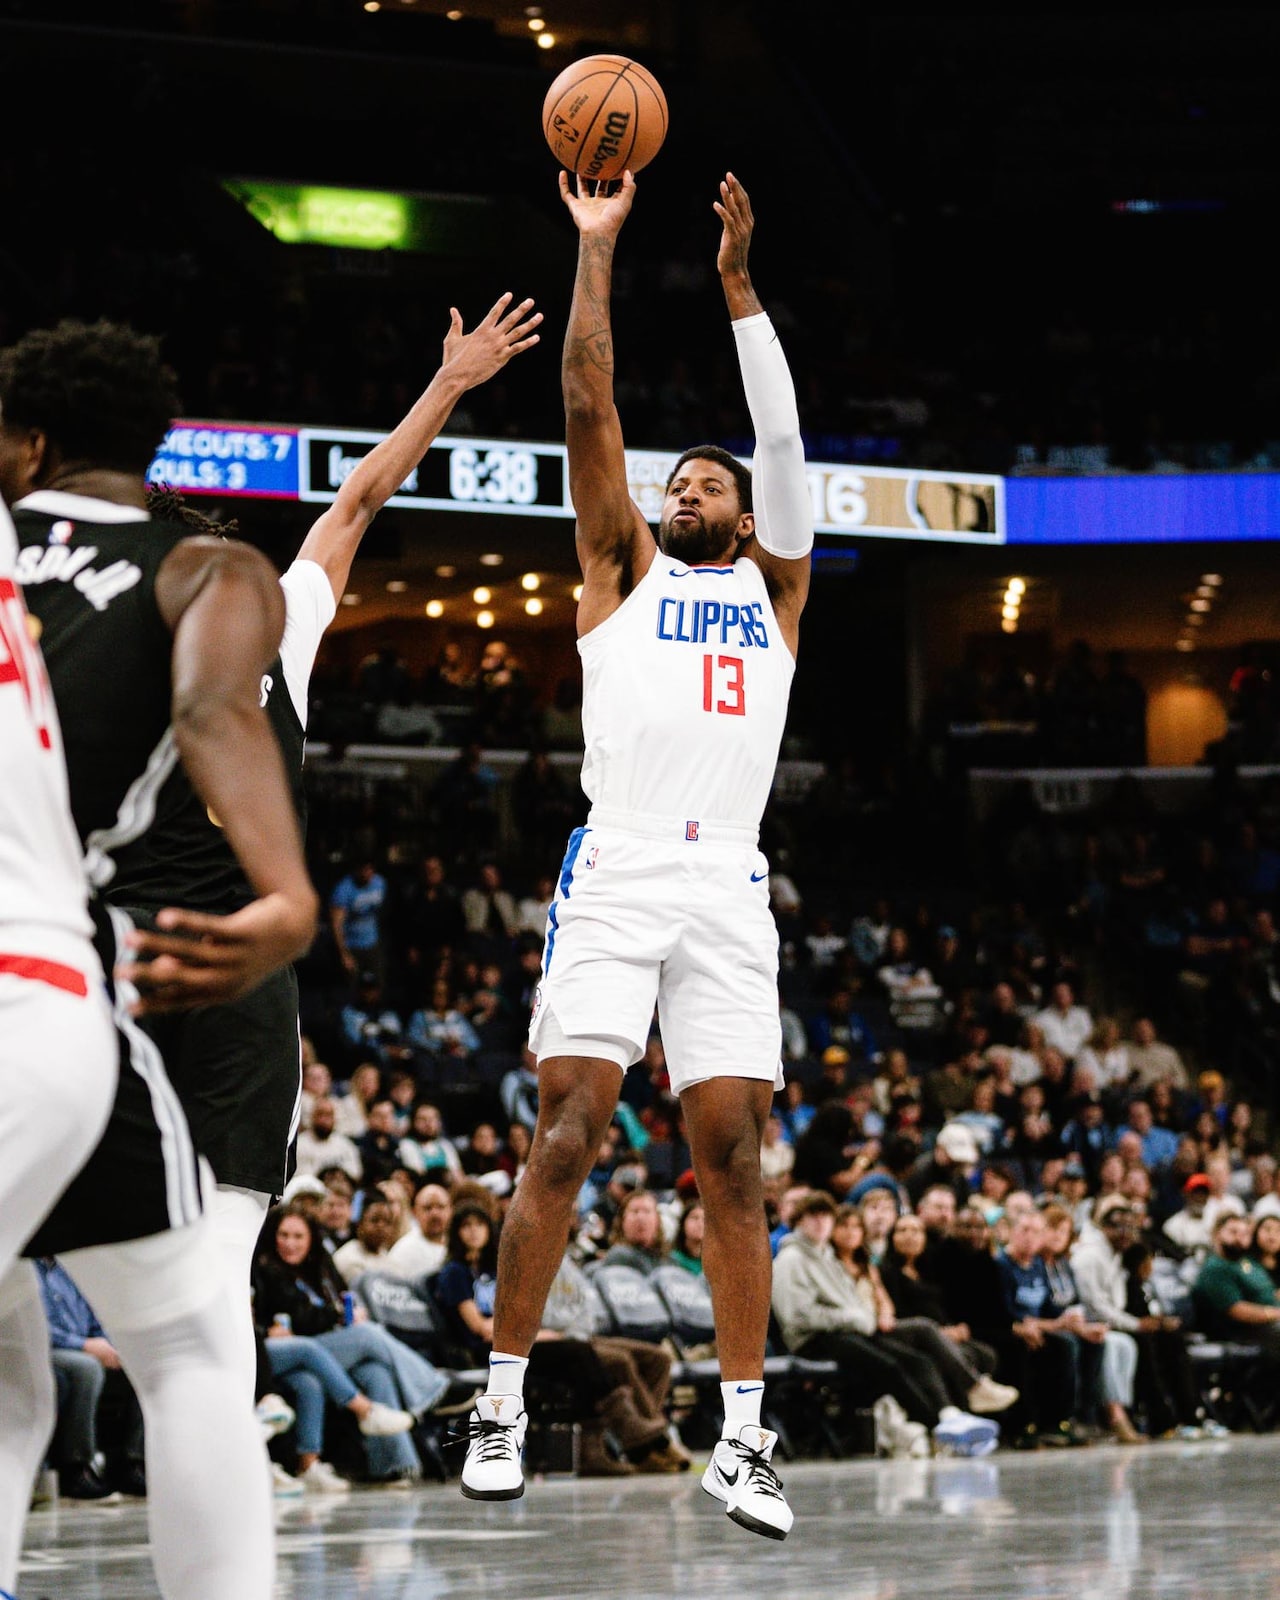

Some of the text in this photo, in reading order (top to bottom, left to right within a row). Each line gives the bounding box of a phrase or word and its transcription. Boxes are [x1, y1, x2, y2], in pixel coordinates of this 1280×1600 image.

[583, 111, 631, 177] Wilson
[148, 458, 247, 490] OULS: 3
[272, 435, 292, 461] 7
[450, 447, 539, 504] 6:38
[806, 472, 868, 526] 16
[656, 596, 769, 649] CLIPPRS
[703, 654, 746, 716] 13
